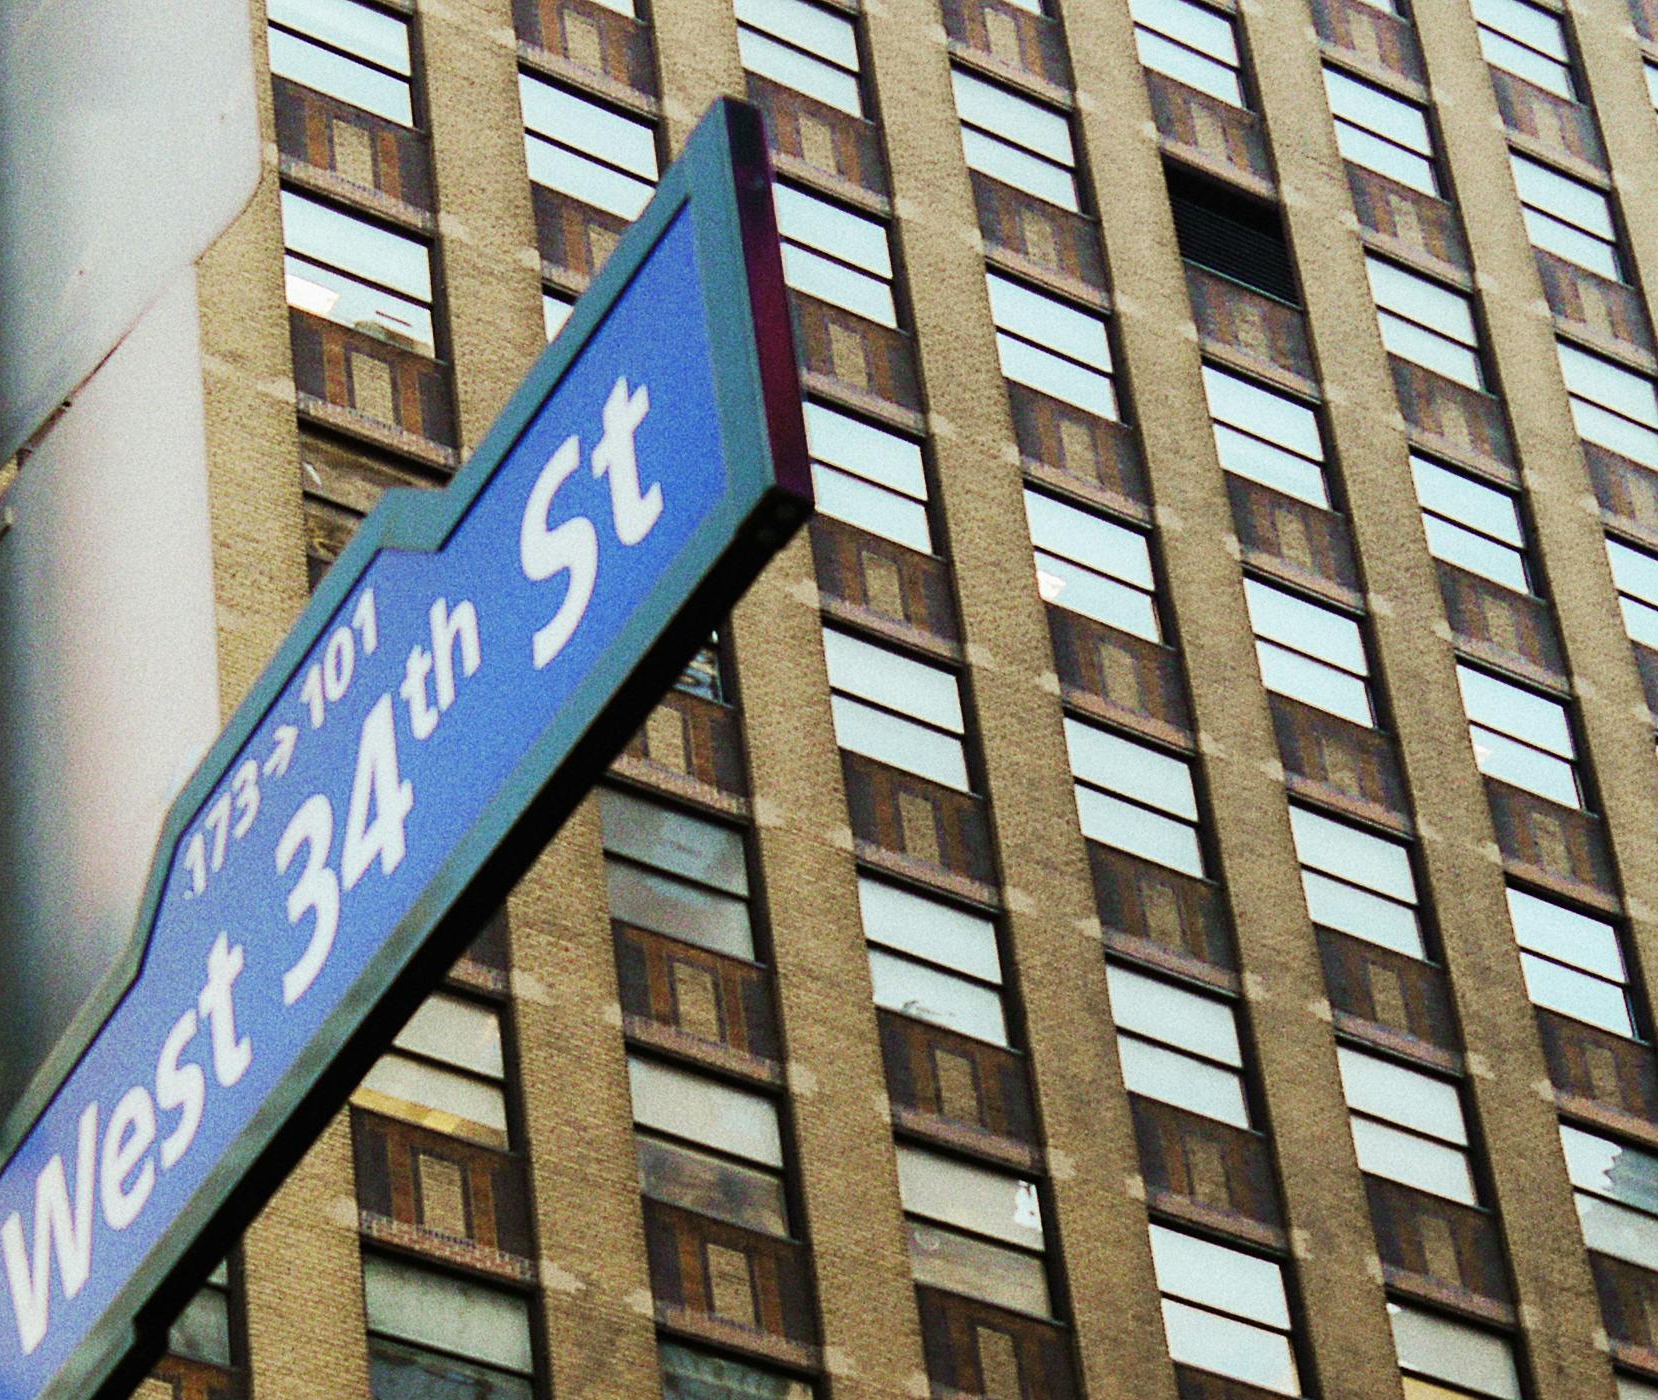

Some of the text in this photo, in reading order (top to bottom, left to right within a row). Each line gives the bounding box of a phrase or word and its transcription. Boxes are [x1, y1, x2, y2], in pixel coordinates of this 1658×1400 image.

[0, 379, 663, 1356] West 34th St
[183, 587, 378, 894] 173 101
